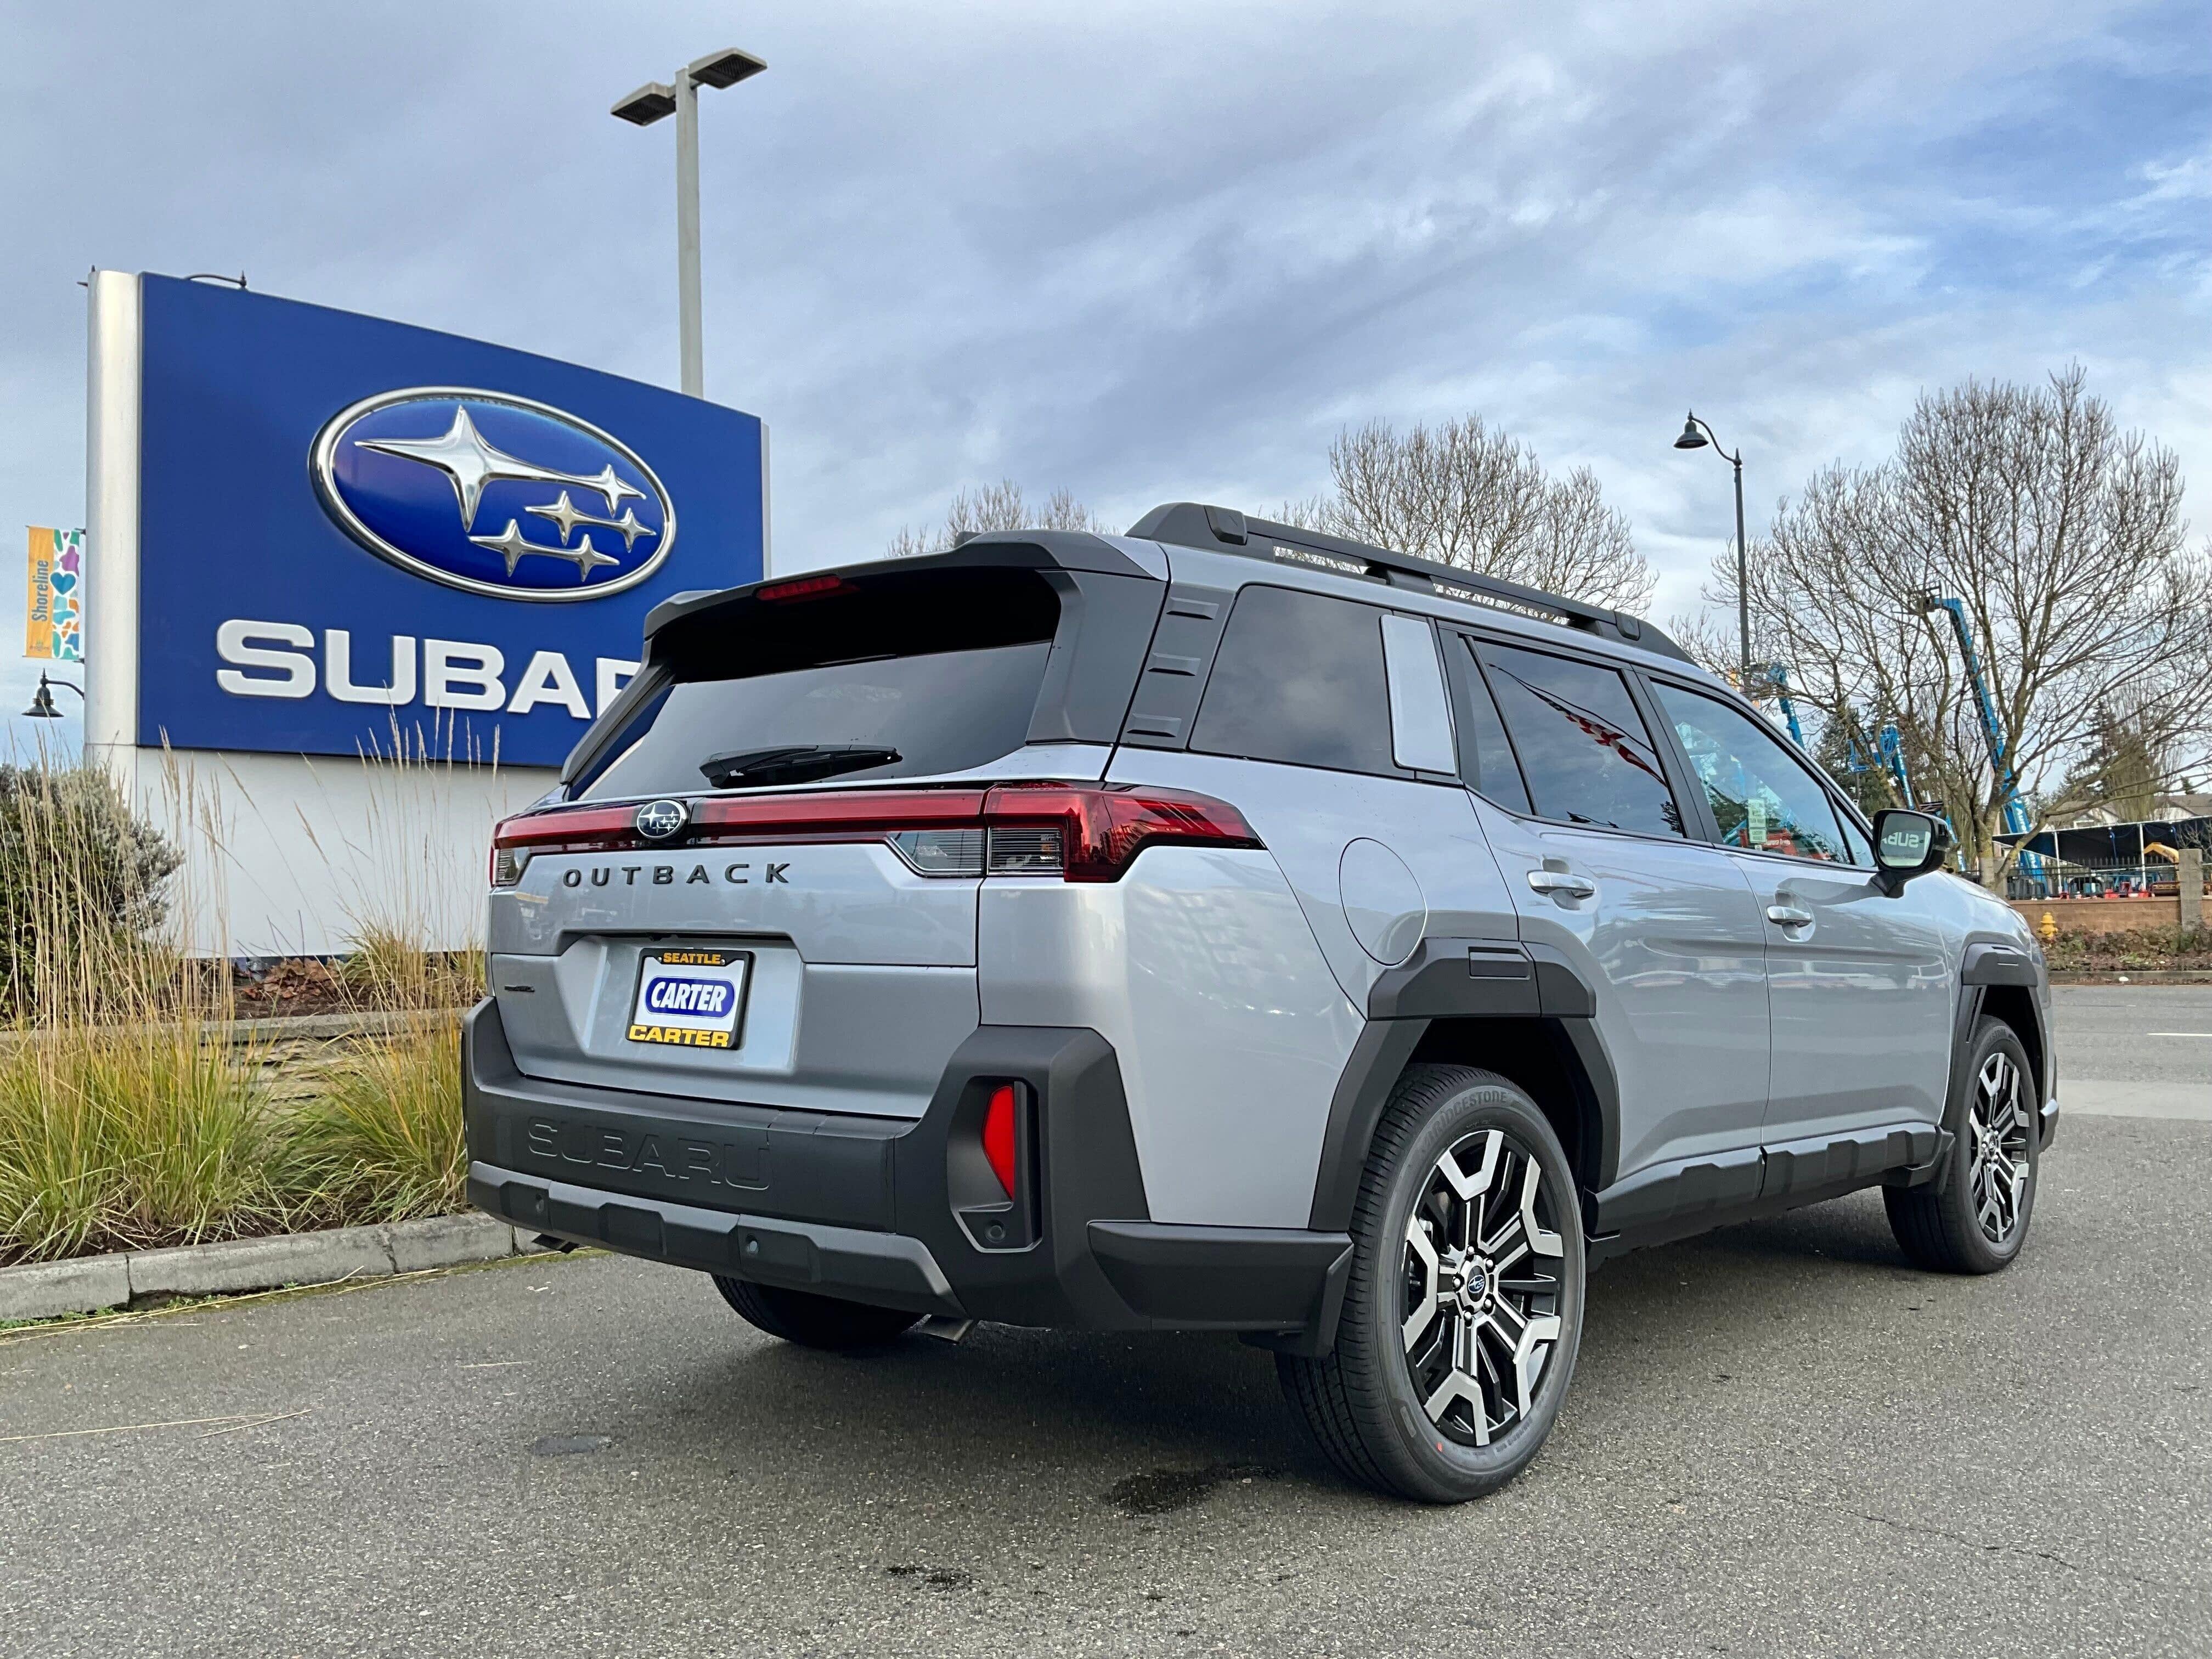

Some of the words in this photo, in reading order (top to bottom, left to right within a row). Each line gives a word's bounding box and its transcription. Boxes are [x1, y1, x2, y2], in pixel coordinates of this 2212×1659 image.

[31, 560, 49, 622] Shoreline
[216, 619, 641, 720] SUBA
[562, 863, 791, 888] OUTBACK
[663, 952, 722, 965] SEATTLE
[651, 981, 727, 1012] CARTER
[629, 1025, 730, 1047] CARTER
[528, 1115, 770, 1191] SUBARU
